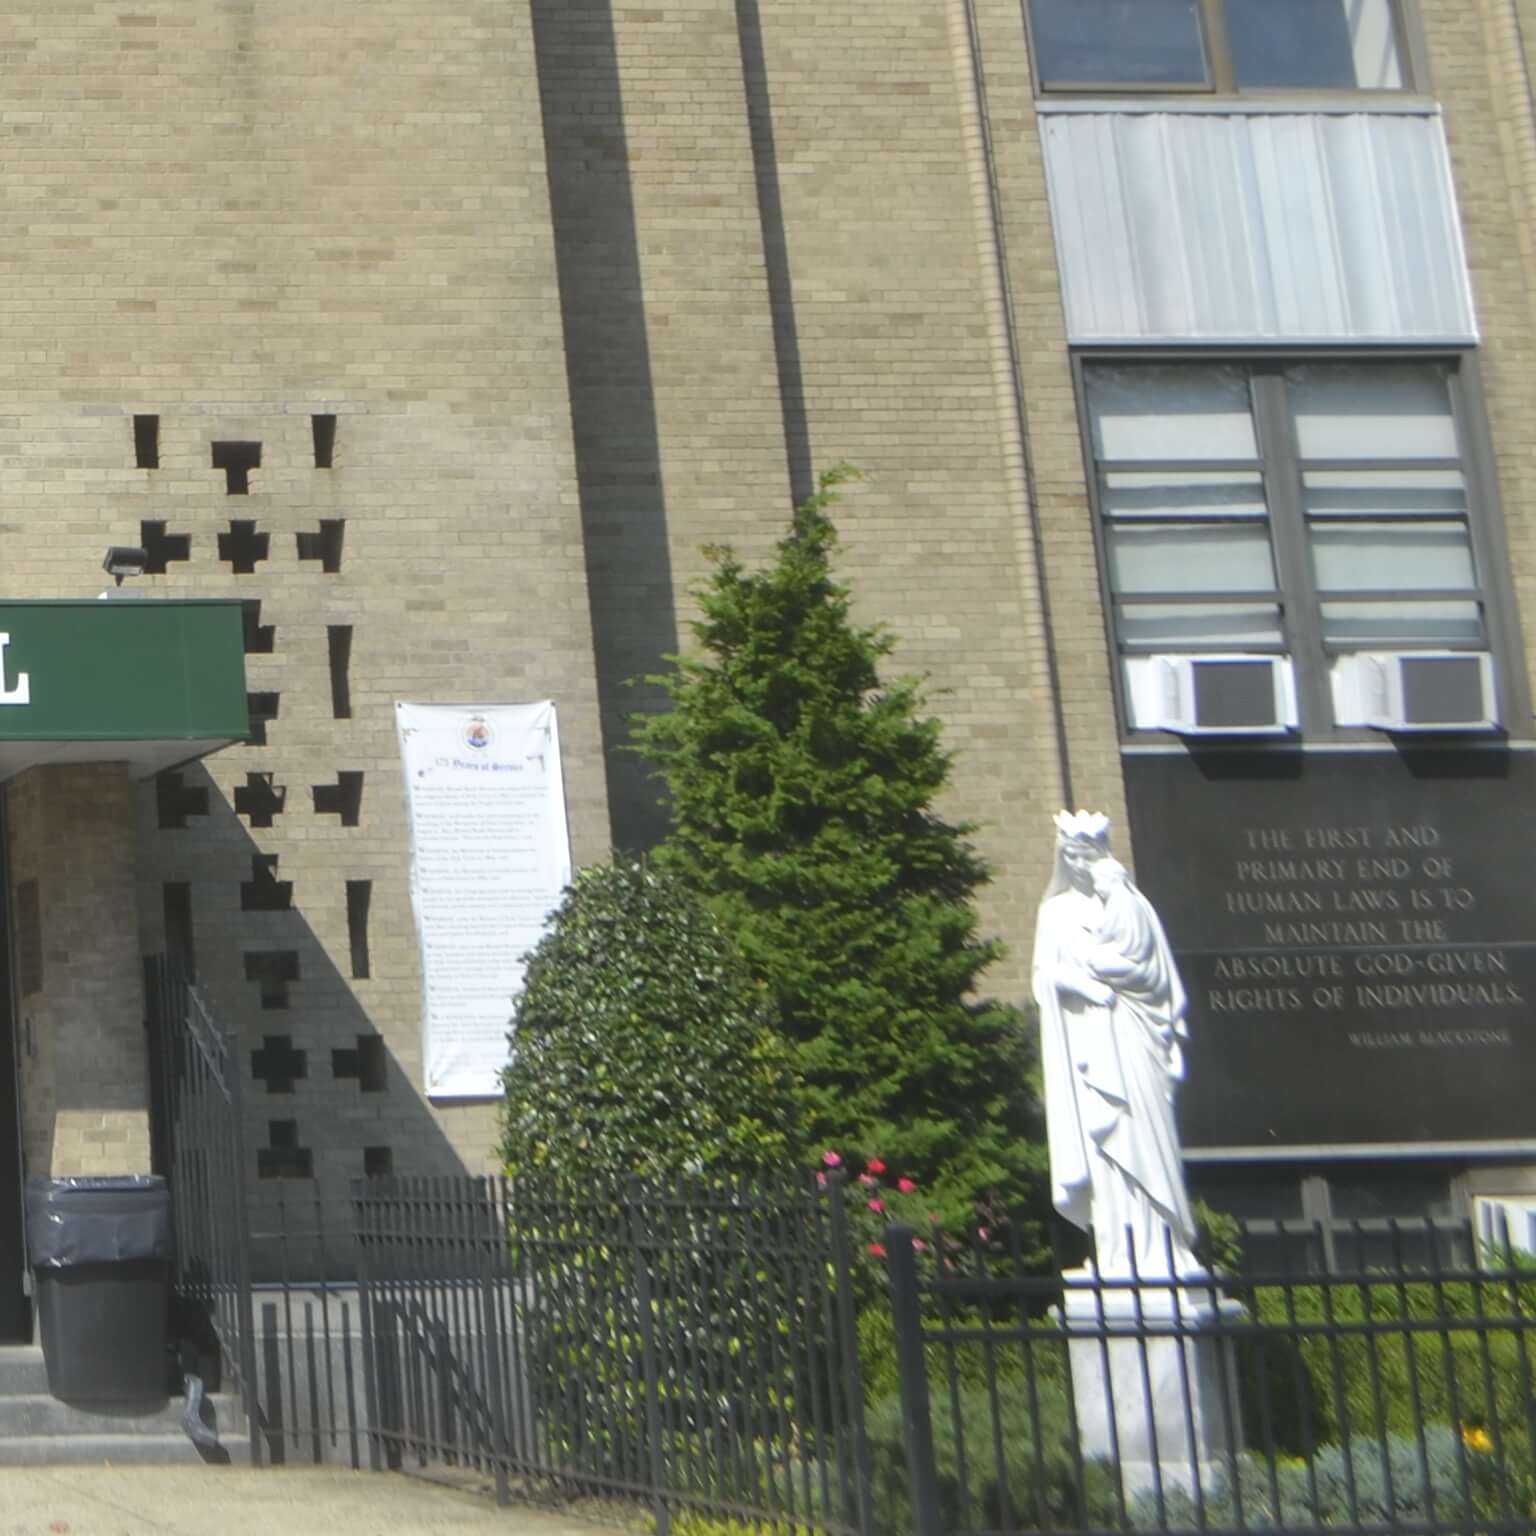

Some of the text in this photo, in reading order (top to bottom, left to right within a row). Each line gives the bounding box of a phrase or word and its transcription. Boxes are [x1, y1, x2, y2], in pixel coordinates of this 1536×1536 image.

[1243, 825, 1440, 850] THE FIRST AND
[1236, 856, 1455, 882] PRIMARY END OF
[1225, 887, 1475, 914] HUMAN LAWS IS TO
[1263, 919, 1446, 945] MAINTAIN THE
[1214, 951, 1507, 978] ABSOLUTE GOD-GIVEN
[1207, 987, 1303, 1011] RIGHTS
[1312, 986, 1345, 1009] OF
